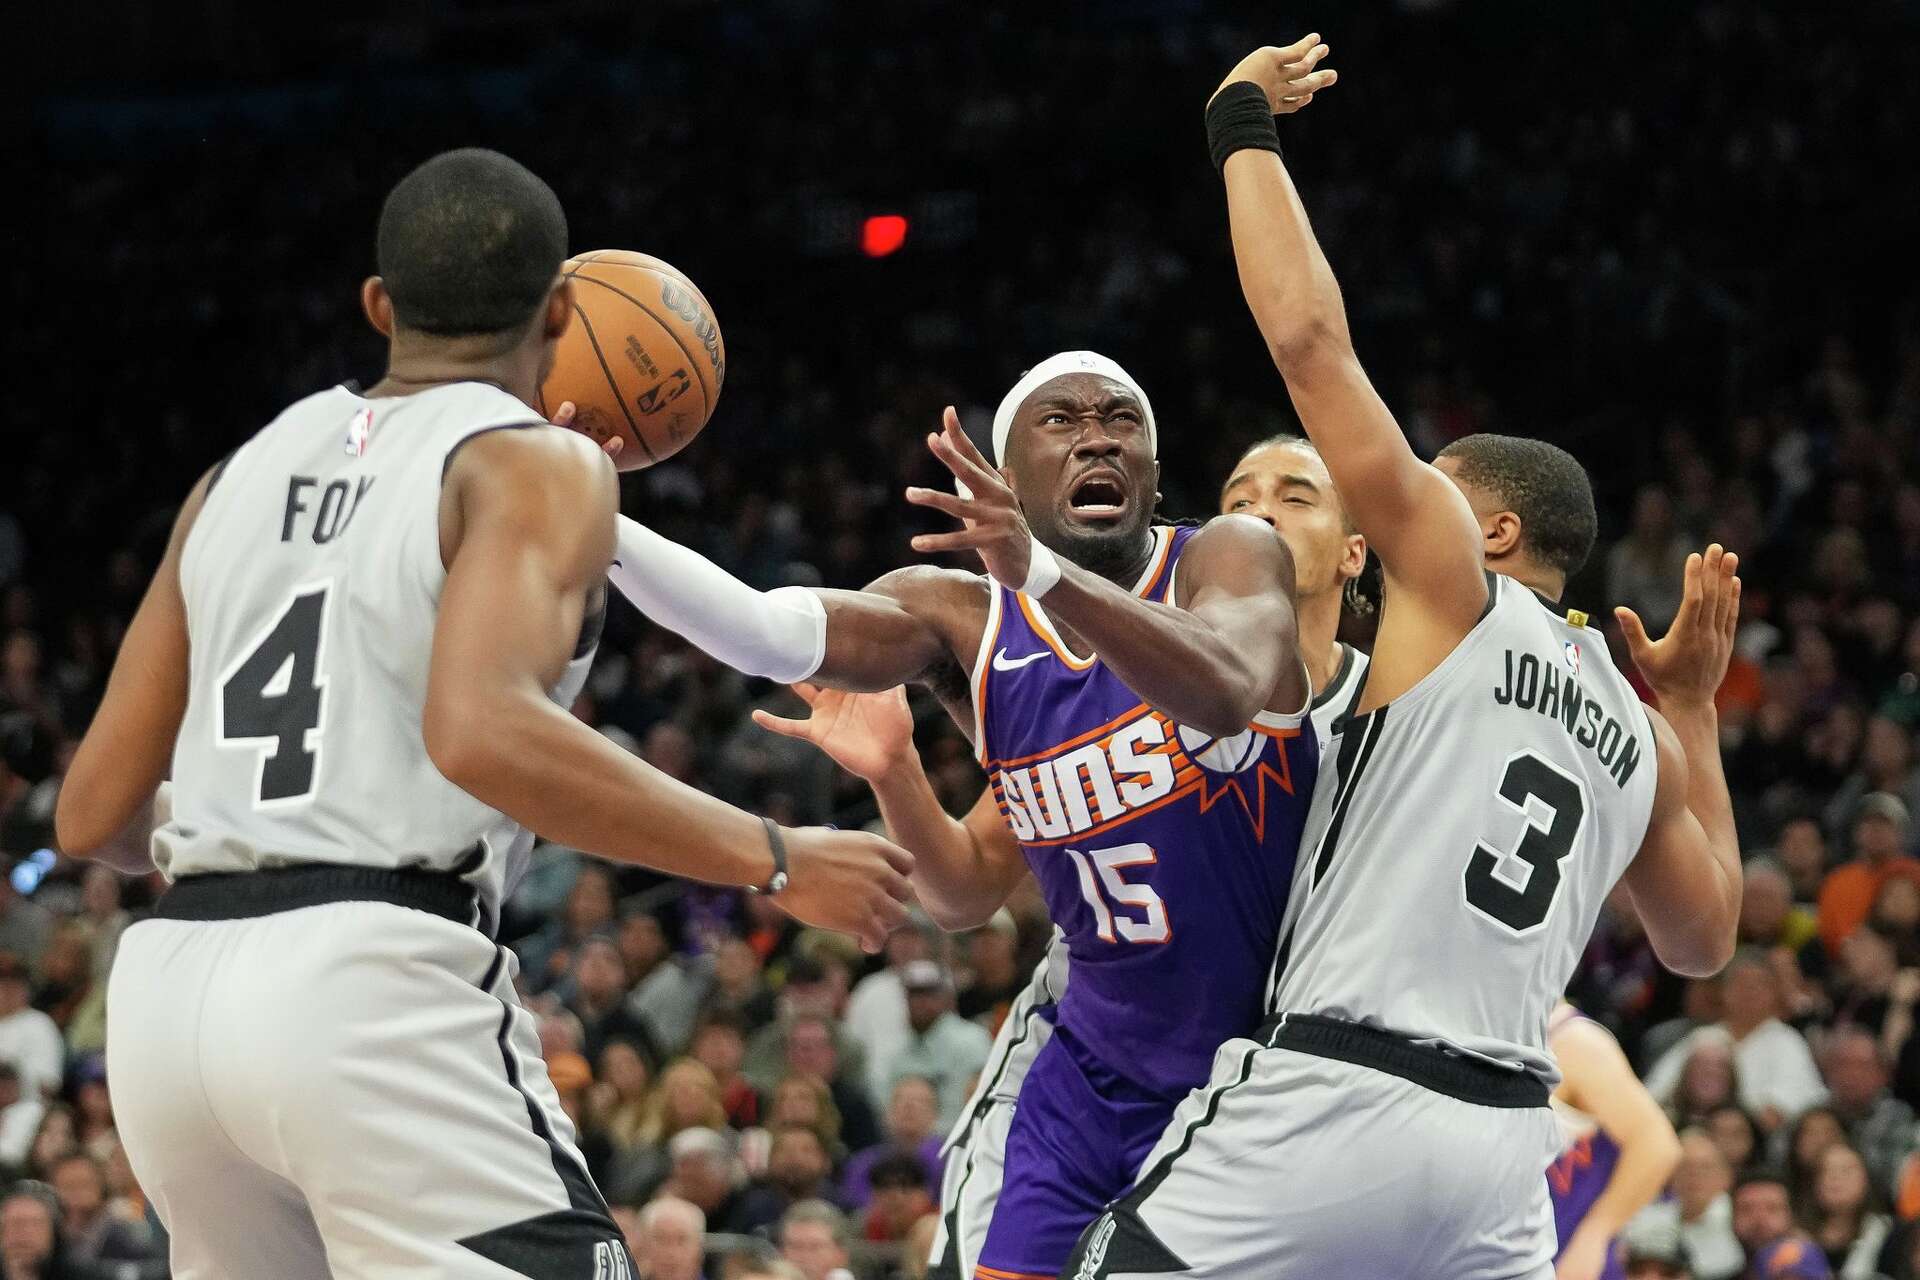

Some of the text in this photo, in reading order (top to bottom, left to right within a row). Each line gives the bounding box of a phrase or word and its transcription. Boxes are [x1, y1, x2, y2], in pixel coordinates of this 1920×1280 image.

[217, 579, 334, 808] 4
[1494, 649, 1642, 790] JOHNSON
[1000, 715, 1176, 841] SUNS
[1461, 746, 1589, 937] 3
[1064, 842, 1173, 944] 15
